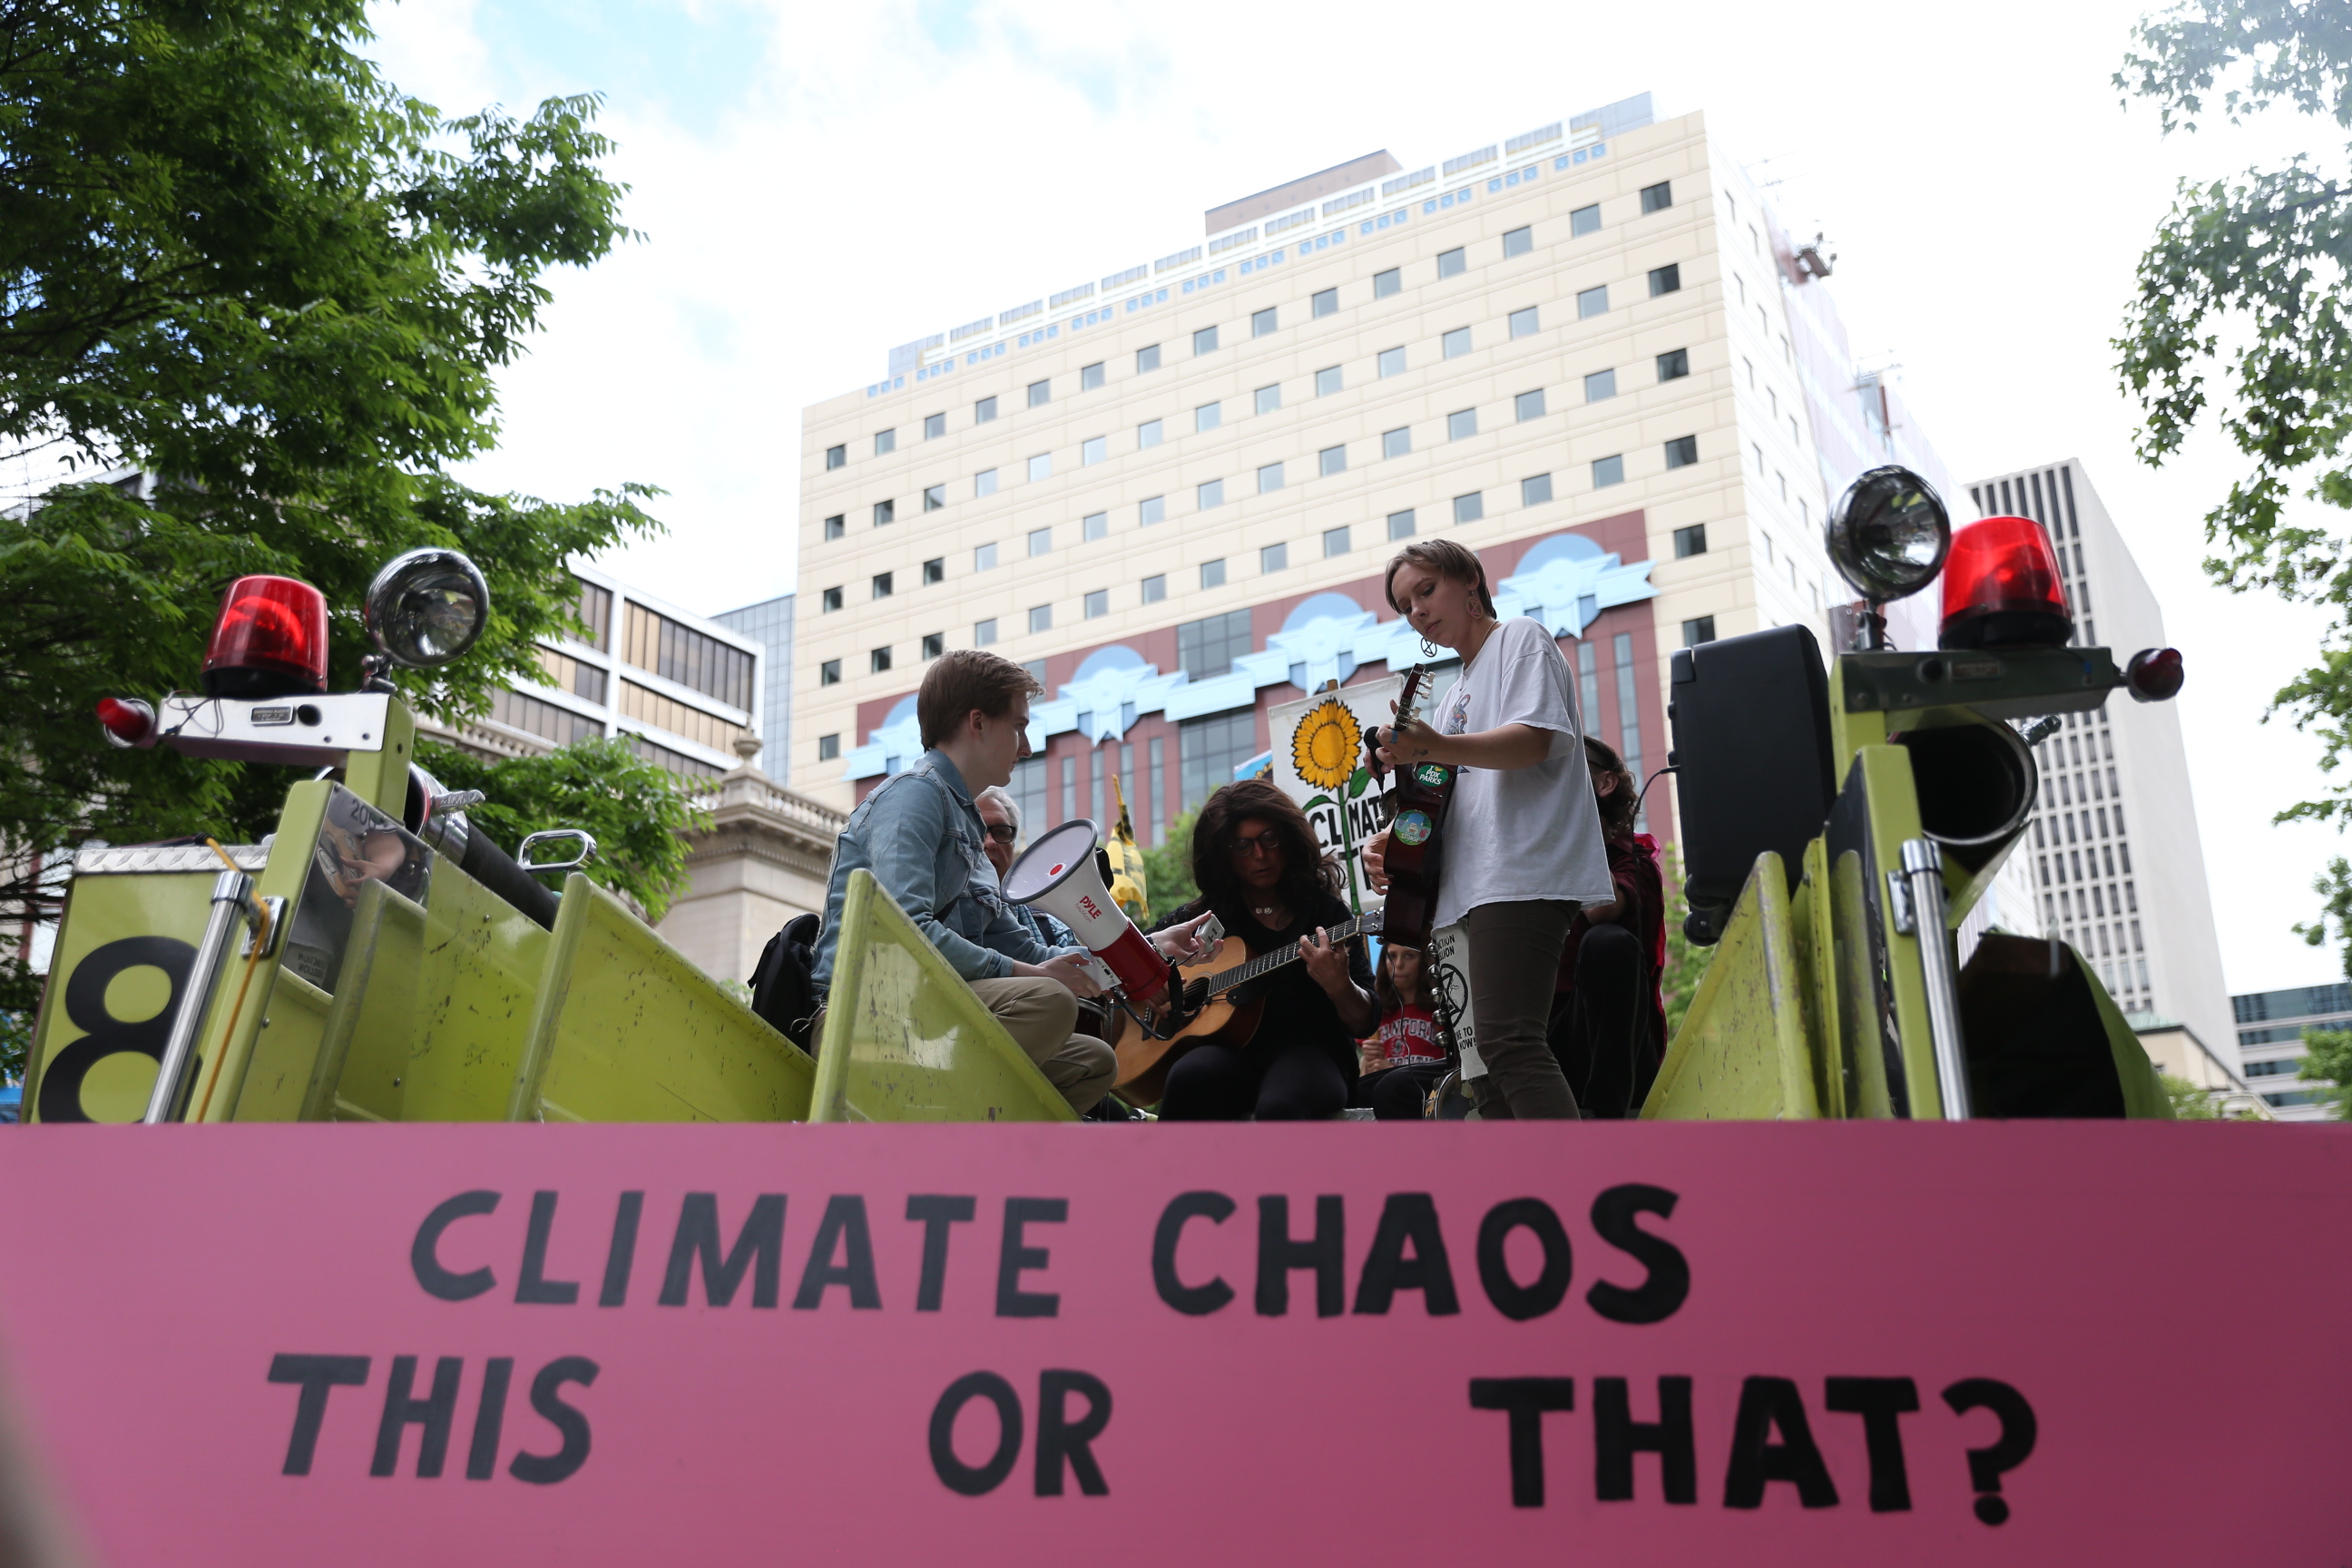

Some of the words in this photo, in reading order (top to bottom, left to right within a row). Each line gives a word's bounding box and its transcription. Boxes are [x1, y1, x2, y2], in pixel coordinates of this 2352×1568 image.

[1418, 774, 1443, 785] PARKS
[1426, 769, 1441, 779] PDX
[39, 936, 203, 1123] 8
[1463, 1026, 1473, 1037] TO
[411, 1191, 1068, 1318] CLIMATE
[1152, 1184, 1690, 1325] CHAOS
[267, 1353, 600, 1485] THIS
[927, 1369, 1112, 1498] OR
[1469, 1376, 2039, 1527] THAT?
